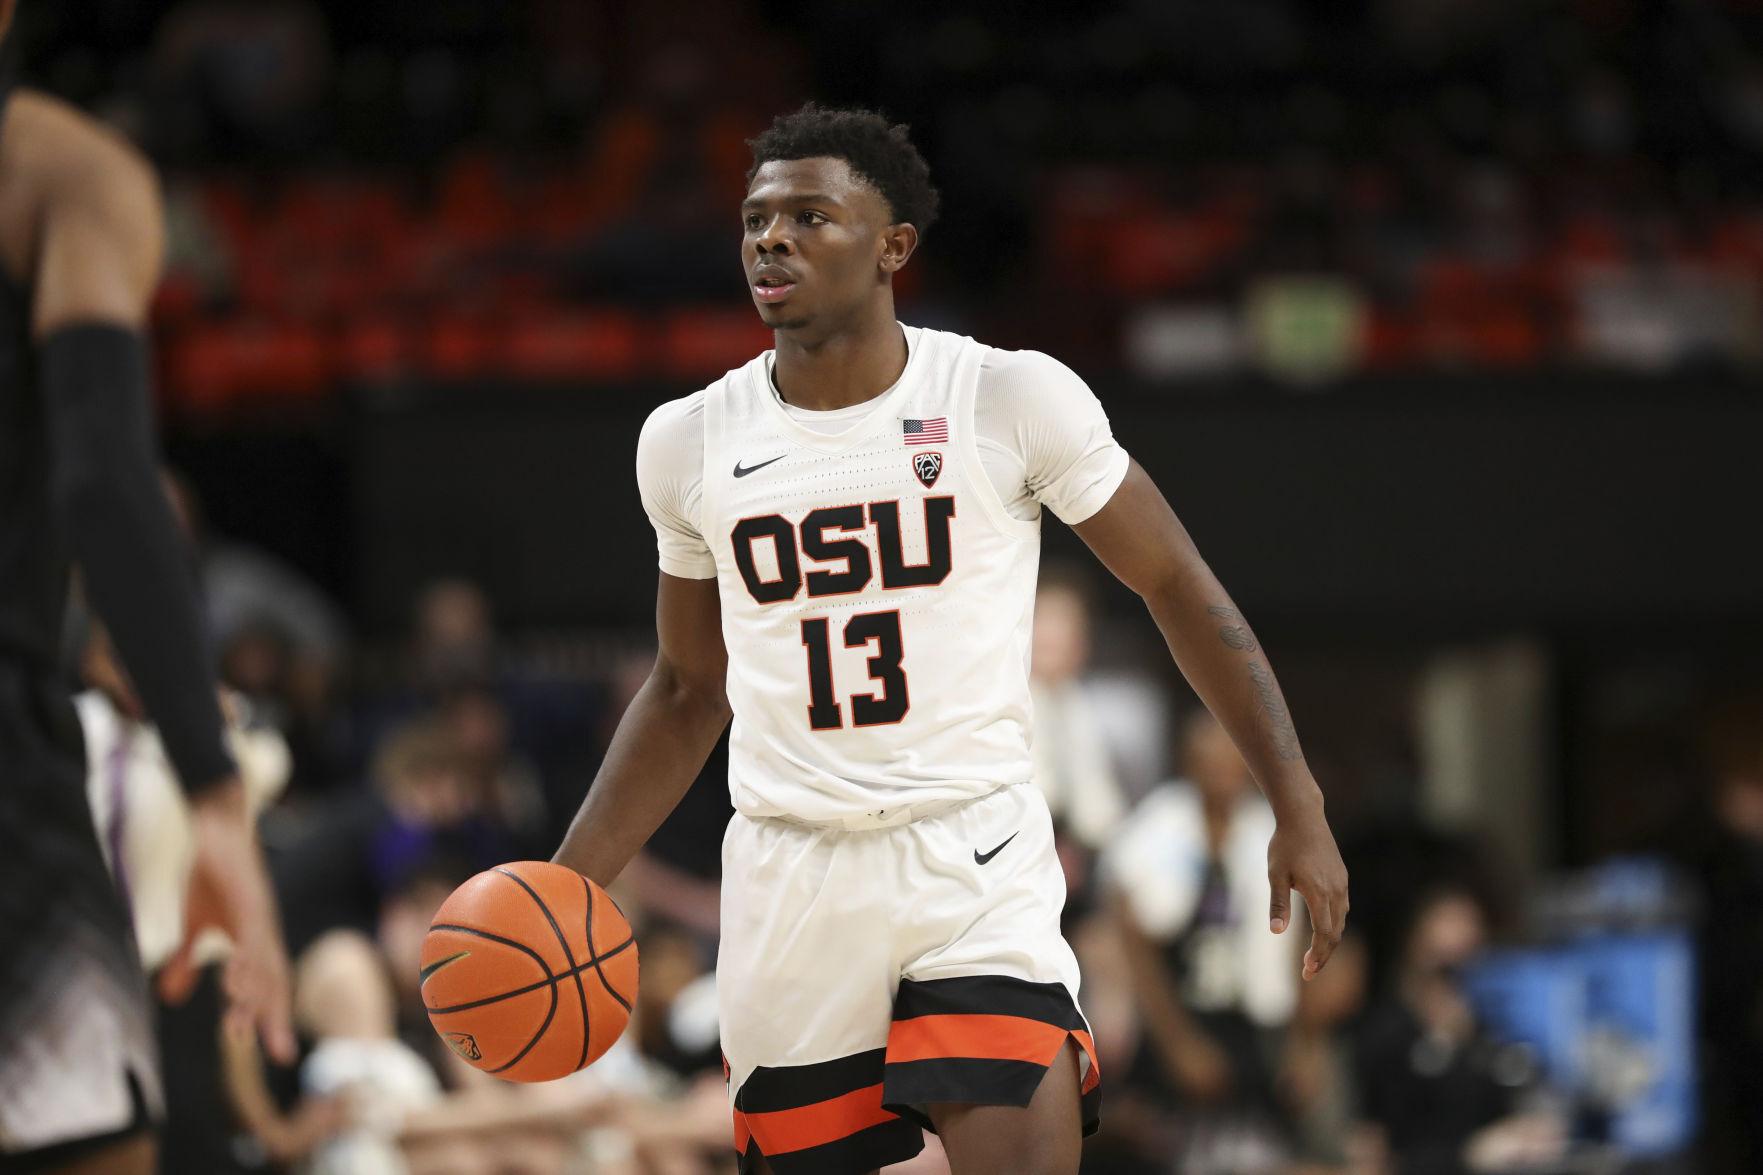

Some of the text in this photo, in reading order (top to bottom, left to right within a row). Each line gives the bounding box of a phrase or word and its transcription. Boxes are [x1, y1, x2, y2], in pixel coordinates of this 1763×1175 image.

[914, 453, 942, 474] PAC
[921, 466, 936, 480] 12
[731, 496, 956, 605] OSU
[800, 609, 911, 731] 13
